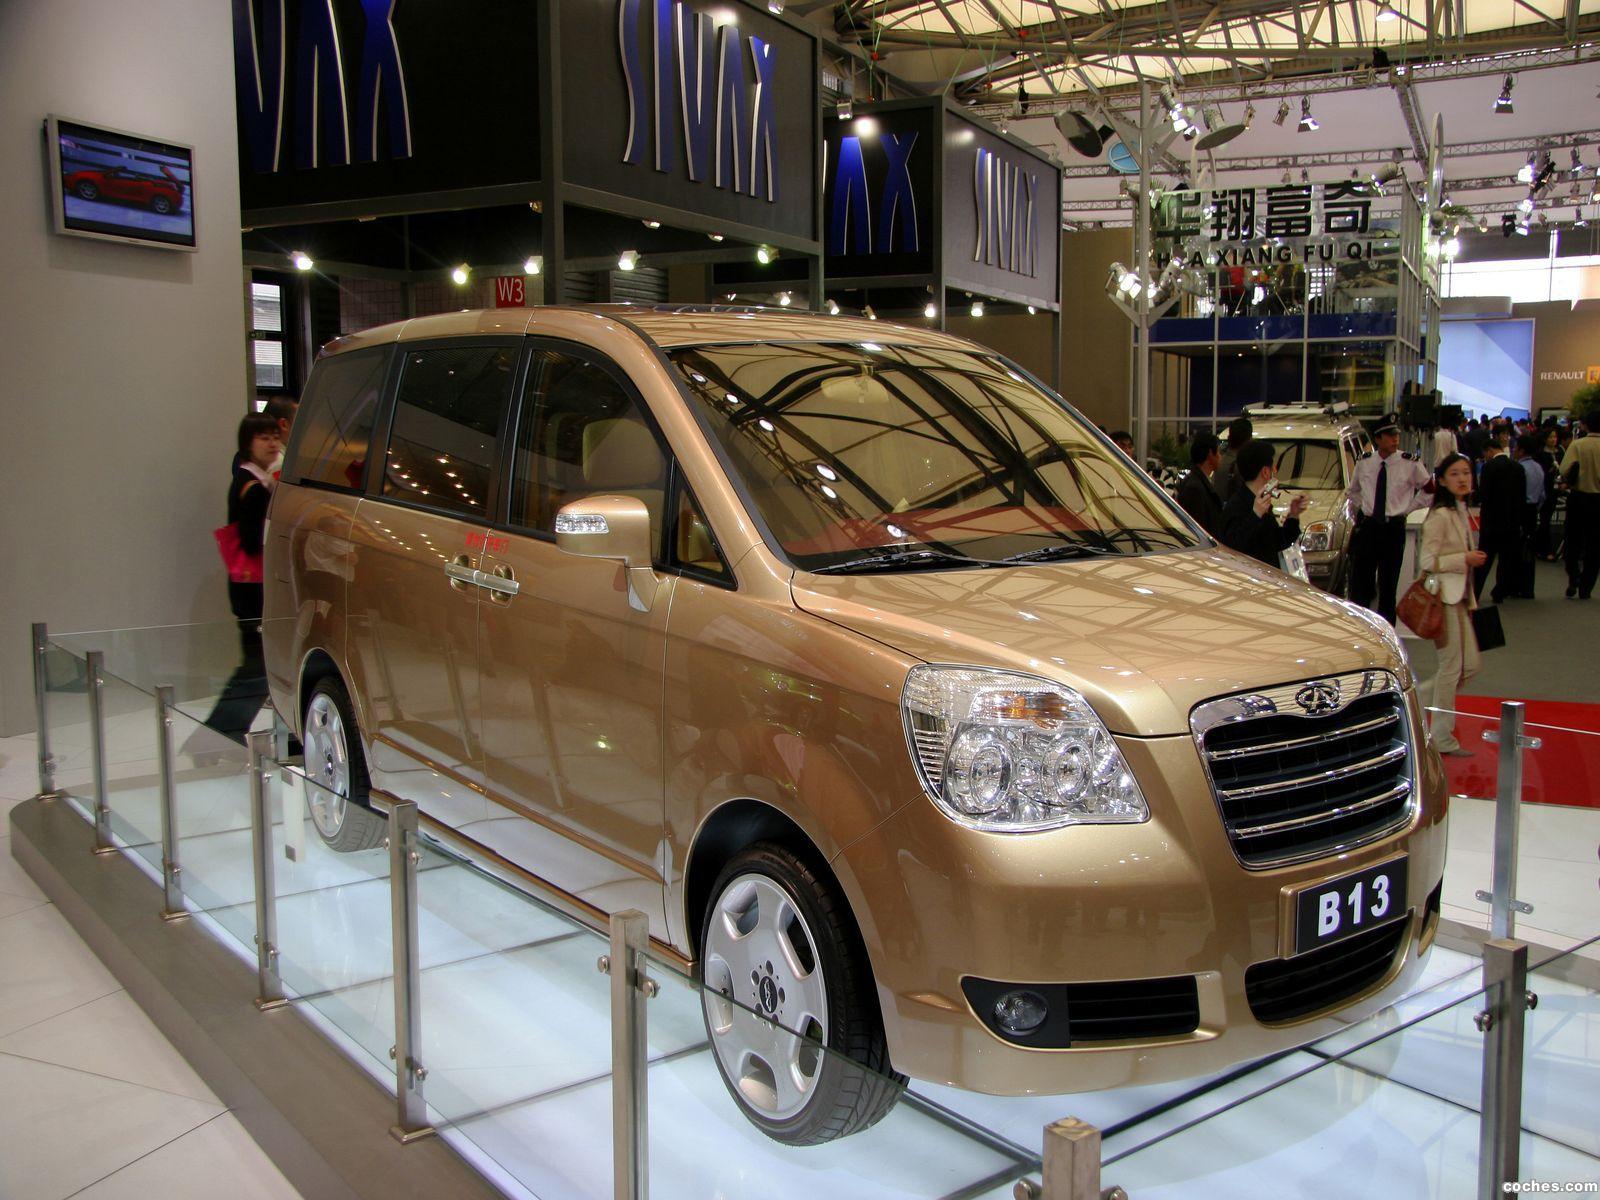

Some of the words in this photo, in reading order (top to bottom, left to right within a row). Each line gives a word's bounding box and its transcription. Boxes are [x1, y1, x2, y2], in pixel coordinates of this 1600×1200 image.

[618, 0, 780, 202] SIVAX
[973, 147, 1038, 279] SIVAX
[1156, 181, 1372, 245] 华翔富奇
[1216, 246, 1292, 266] XIANG
[1304, 243, 1334, 262] FU
[1347, 242, 1372, 260] QI
[497, 277, 524, 303] W3
[1540, 370, 1584, 381] RENAULT
[1318, 874, 1389, 937] B13
